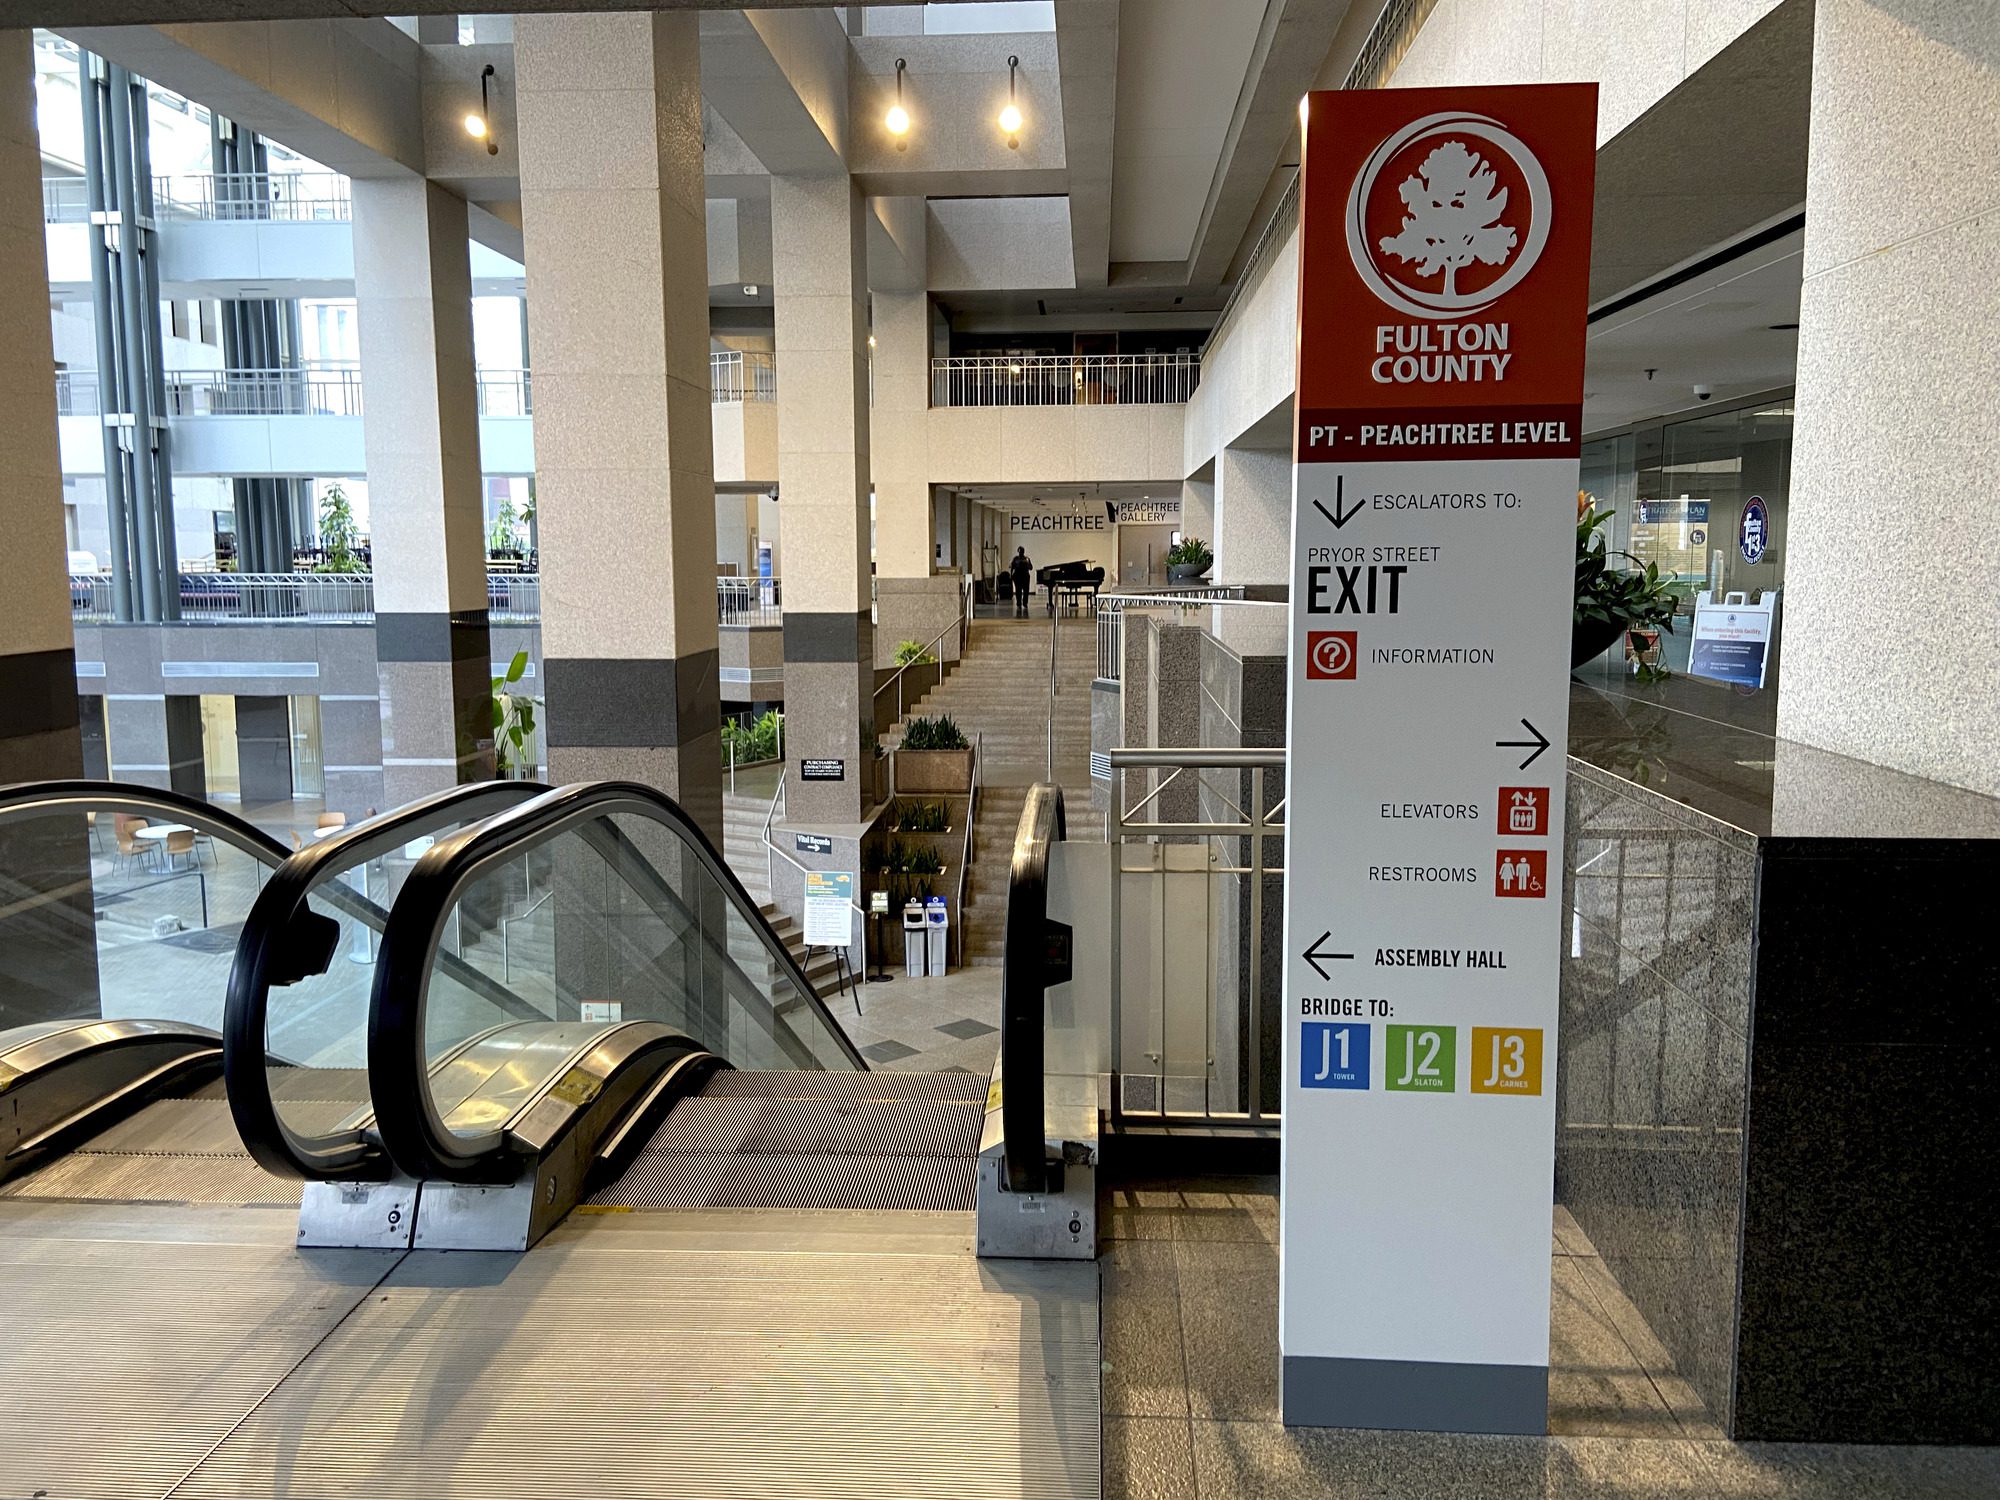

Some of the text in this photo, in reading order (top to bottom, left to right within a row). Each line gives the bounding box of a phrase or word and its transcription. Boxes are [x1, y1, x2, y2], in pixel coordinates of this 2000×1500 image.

[1376, 323, 1509, 354] FULTON
[1371, 353, 1512, 384] COUNTY
[1309, 425, 1339, 447] PT
[1360, 423, 1494, 446] PEACHTREE
[1501, 421, 1571, 444] LEVEL
[1120, 502, 1180, 513] PEACHTREE
[1373, 493, 1521, 510] ESCALATORS TO:
[1010, 515, 1105, 531] PEACHTREE
[1120, 512, 1166, 522] GALLERY
[1308, 546, 1441, 563] PRYOR STREET
[1307, 565, 1408, 614] EXIT
[1372, 648, 1494, 664] INFORMATION
[1381, 803, 1479, 819] ELEVATORS
[1369, 866, 1477, 882] RESTROOMS
[1374, 948, 1507, 969] ASSEMBLY HALL
[1301, 997, 1394, 1017] BRIDGE TO:
[1314, 1028, 1350, 1081] J1
[1397, 1030, 1441, 1085] J2
[1483, 1034, 1525, 1087] J3
[1333, 1073, 1355, 1081] TOWER
[1414, 1078, 1443, 1087] SLATON
[1499, 1079, 1529, 1088] CARNES
